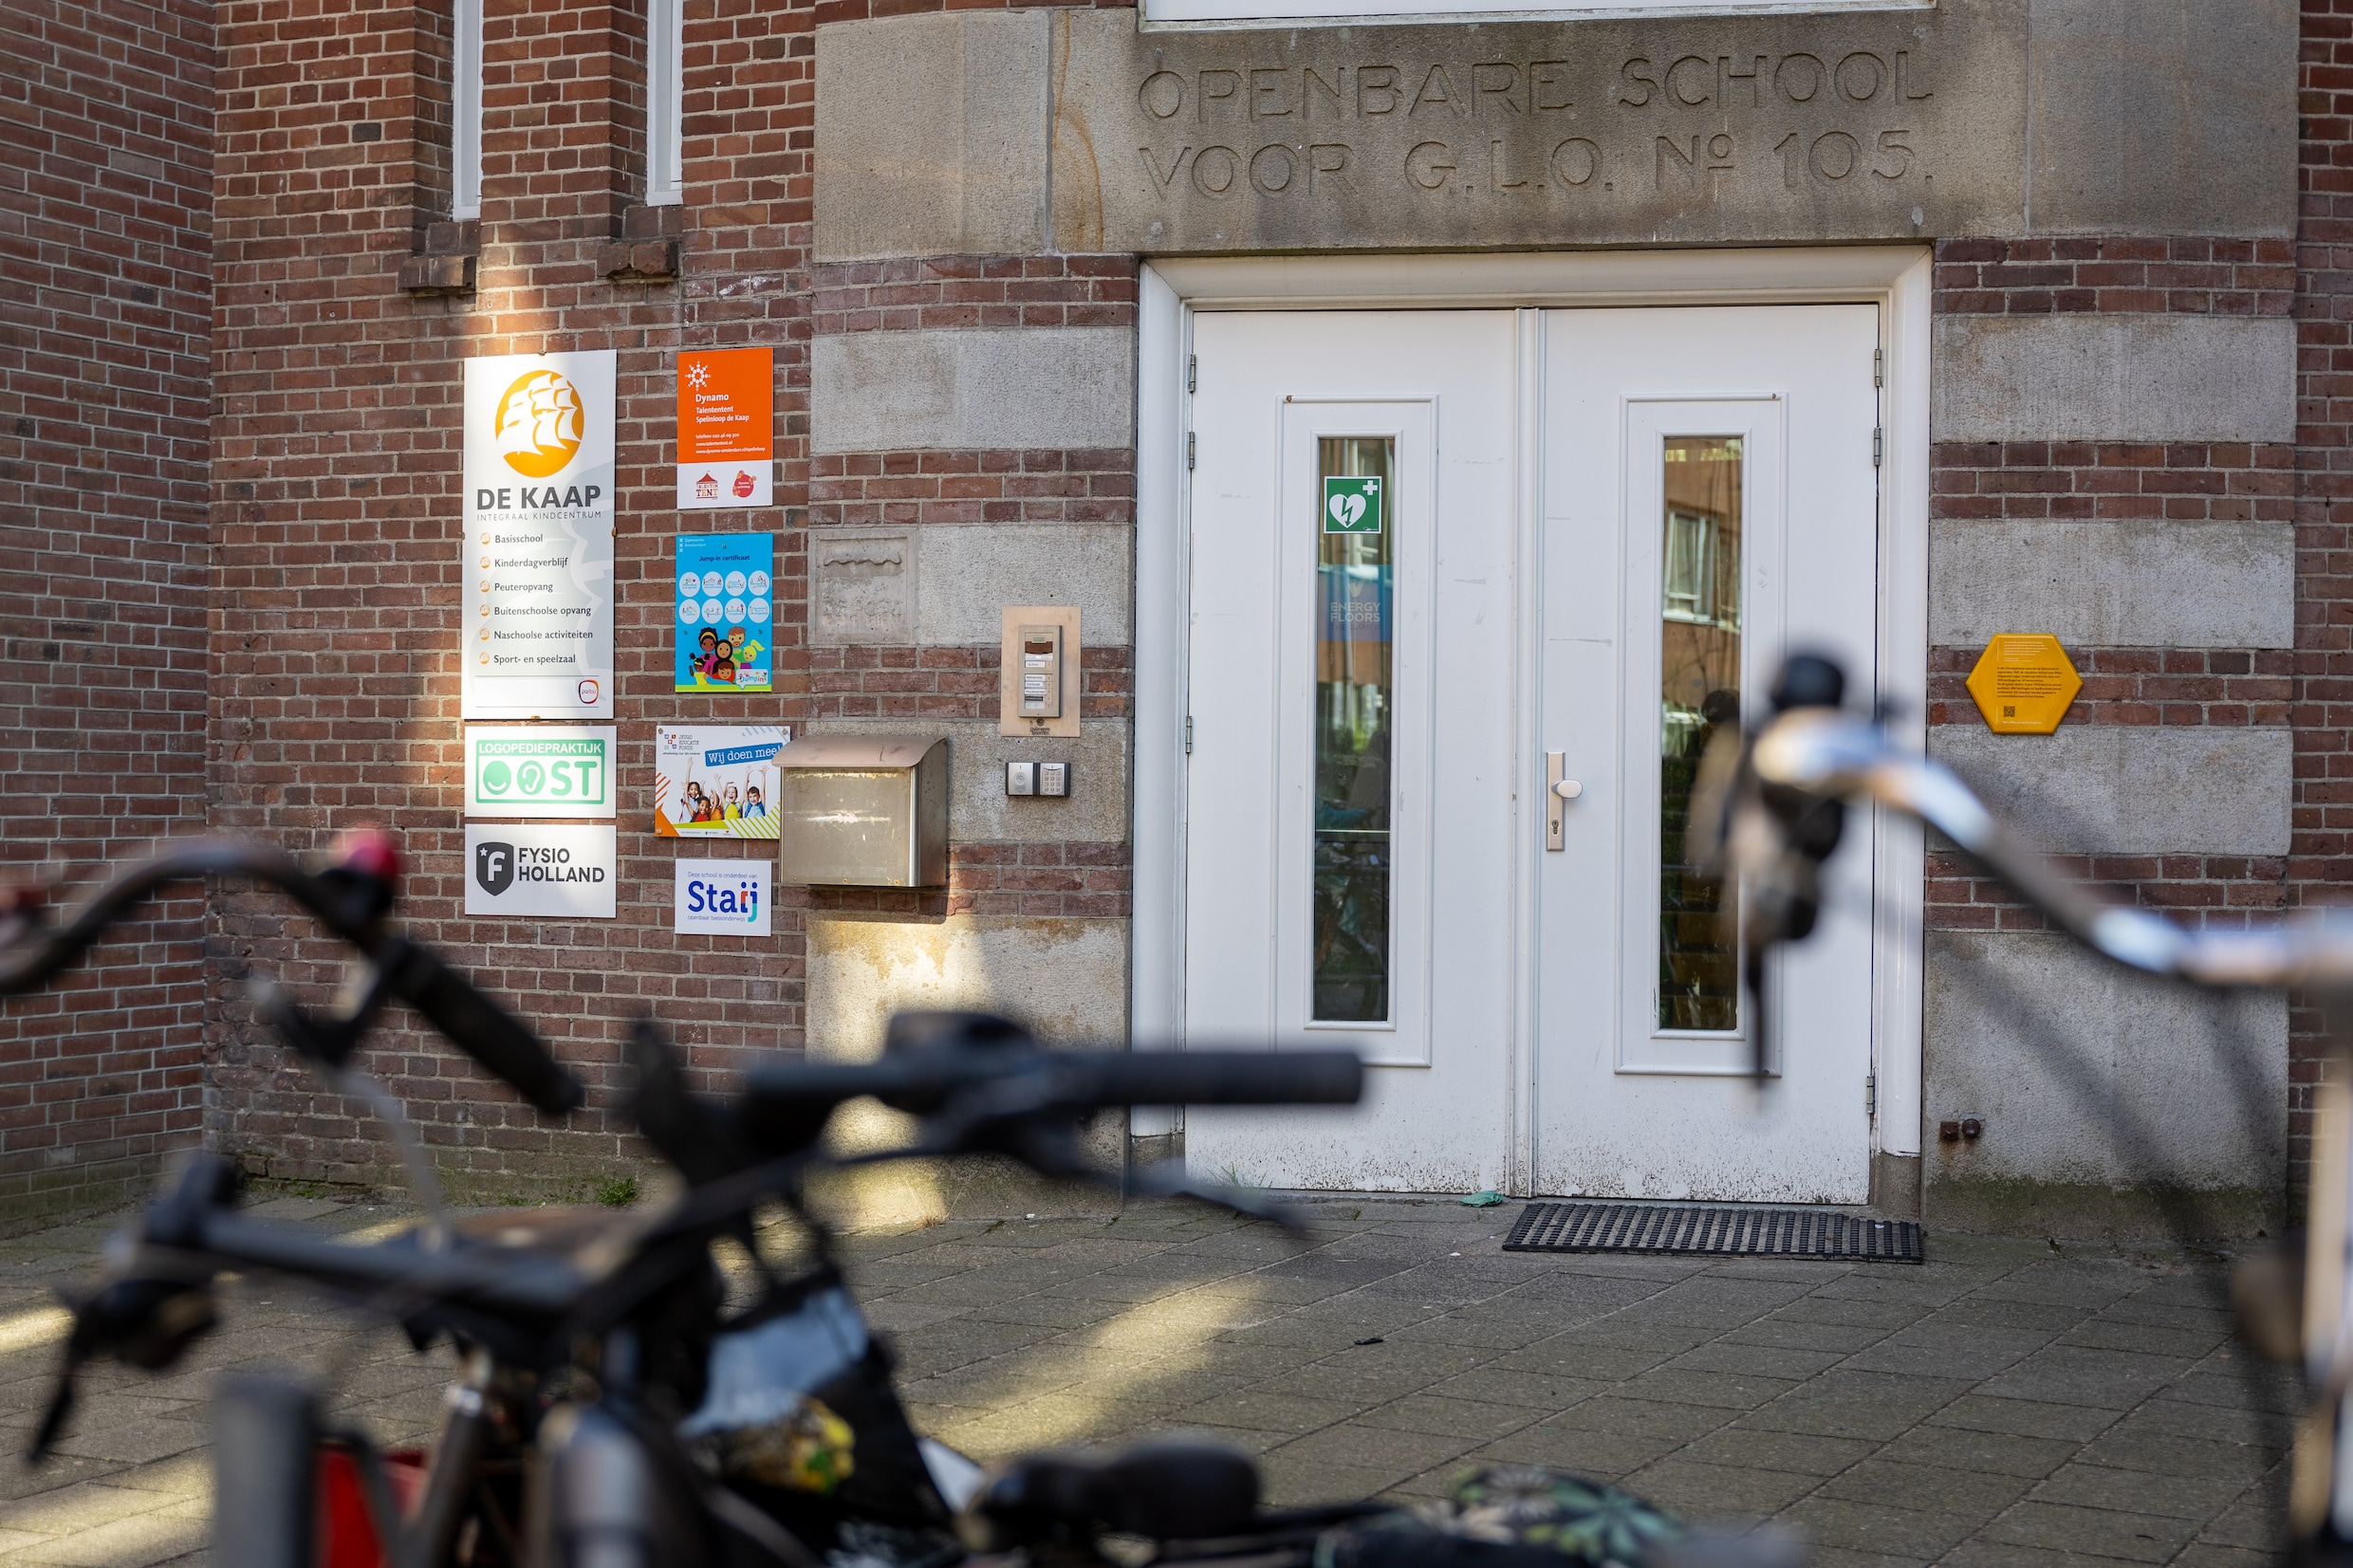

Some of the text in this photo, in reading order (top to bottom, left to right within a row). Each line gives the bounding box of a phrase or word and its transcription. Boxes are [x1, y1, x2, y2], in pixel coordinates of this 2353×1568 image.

[1139, 49, 1936, 120] OPENBARE SCHOOL
[1139, 142, 1356, 201] VOOR
[1403, 136, 1614, 194] G.L.O.
[1773, 128, 1934, 190] 105.
[695, 394, 729, 404] Dynamo
[734, 414, 750, 423] Kaap
[477, 485, 602, 510] DE KAAP
[695, 489, 718, 497] TENT
[476, 510, 602, 522] INTEGRAAL KINDCENTRUM
[494, 533, 544, 544] Basisschool
[494, 557, 568, 569] Kinderdagverblijf
[494, 582, 553, 593] Peuteropvang
[494, 606, 592, 617] Buitenschoolse opvang
[1330, 601, 1380, 612] ENERGY
[1330, 612, 1380, 622] FLOORS
[1350, 623, 1380, 632] GAMER
[493, 630, 594, 639] Naschoolse activiteiten
[493, 655, 522, 666] Sport-
[536, 654, 576, 666] speelzaal
[478, 742, 602, 755] LOGOPEDIEPRAKTIJK
[708, 751, 725, 766] Wij
[727, 748, 753, 763] doen
[518, 847, 570, 864] FYSIO
[518, 865, 605, 883] HOLLAND
[688, 880, 758, 922] Staij
